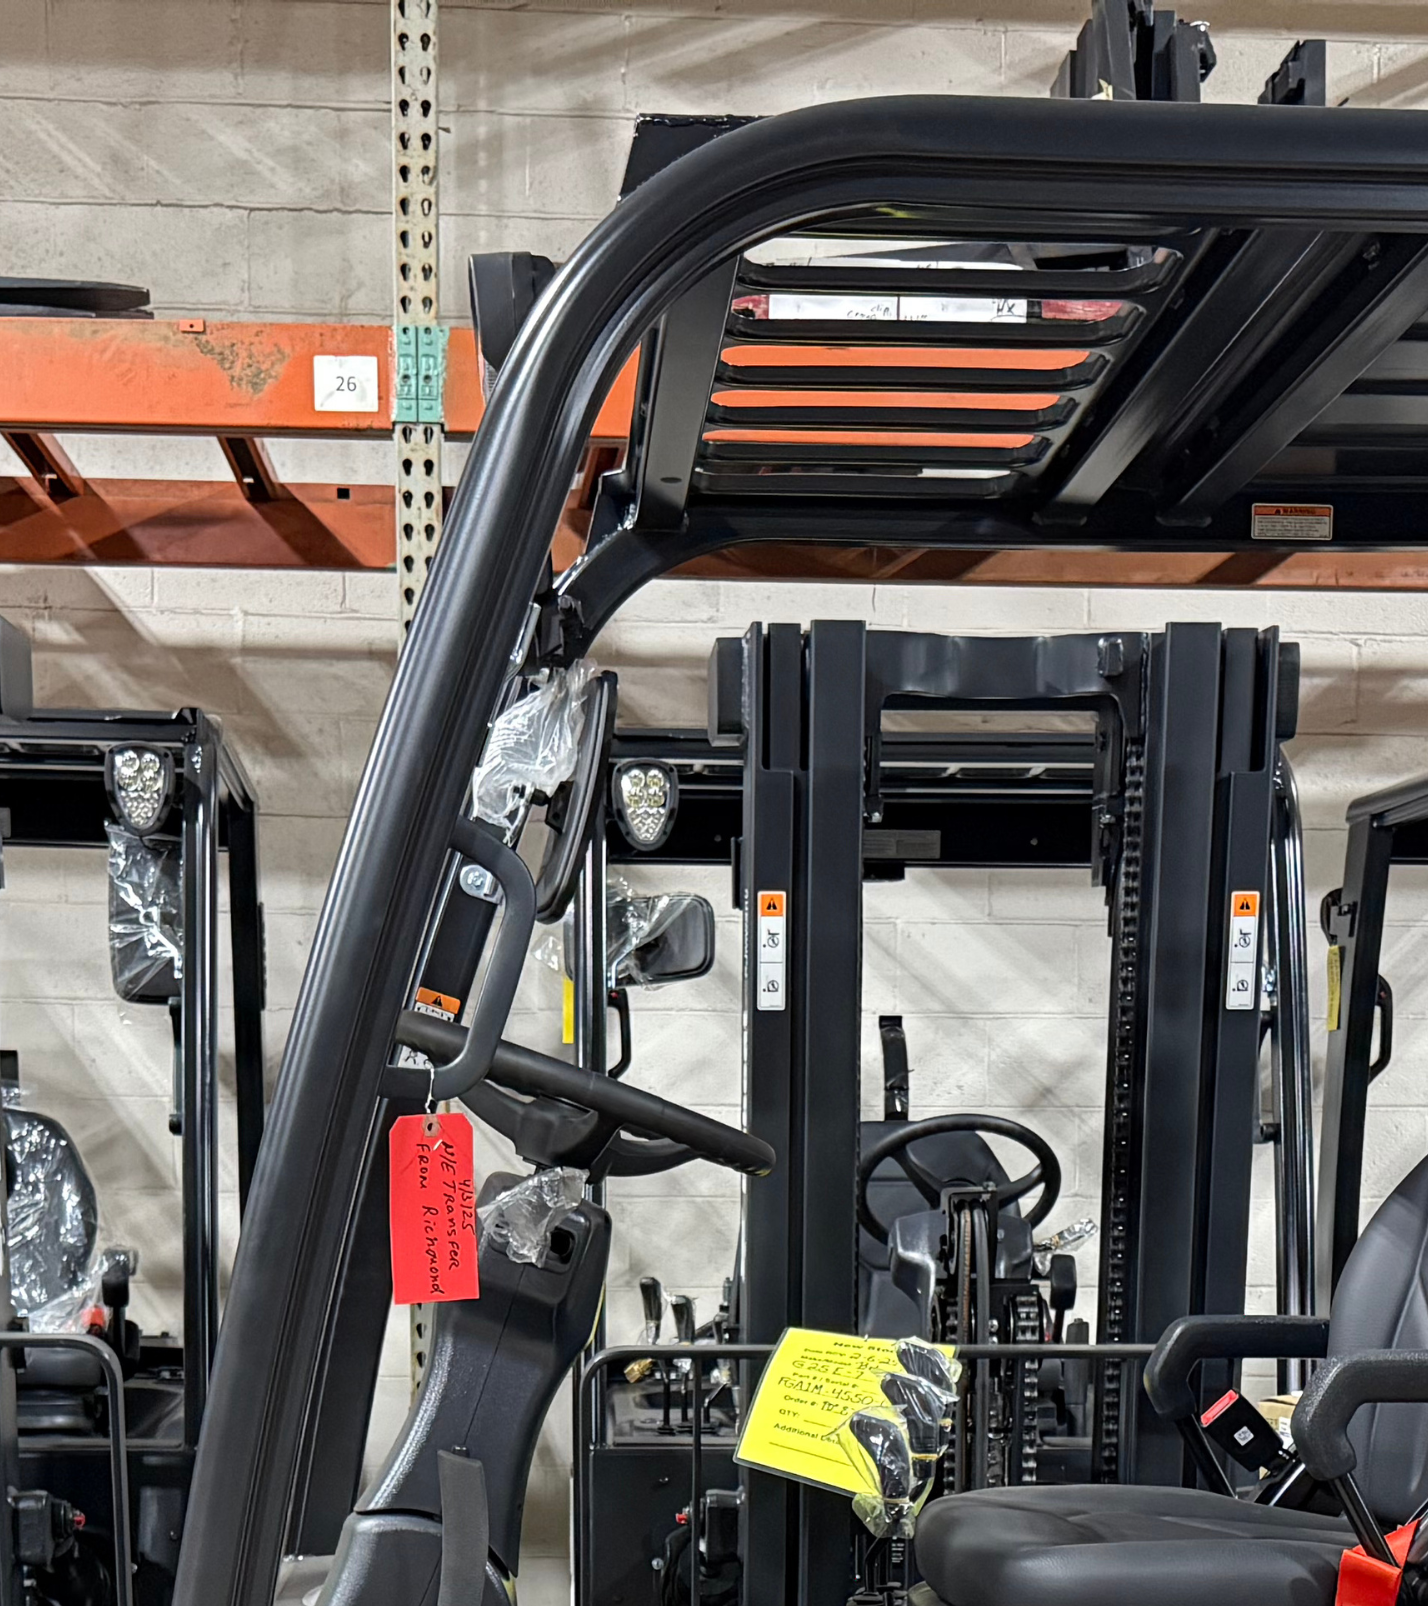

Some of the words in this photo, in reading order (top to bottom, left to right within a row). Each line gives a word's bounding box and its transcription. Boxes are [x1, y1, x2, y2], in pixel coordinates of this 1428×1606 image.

[336, 376, 357, 392] 26
[458, 1179, 475, 1236] 4/3/25
[783, 1394, 808, 1405] Order
[779, 1408, 801, 1418] QTY:
[773, 1422, 819, 1439] Additional
